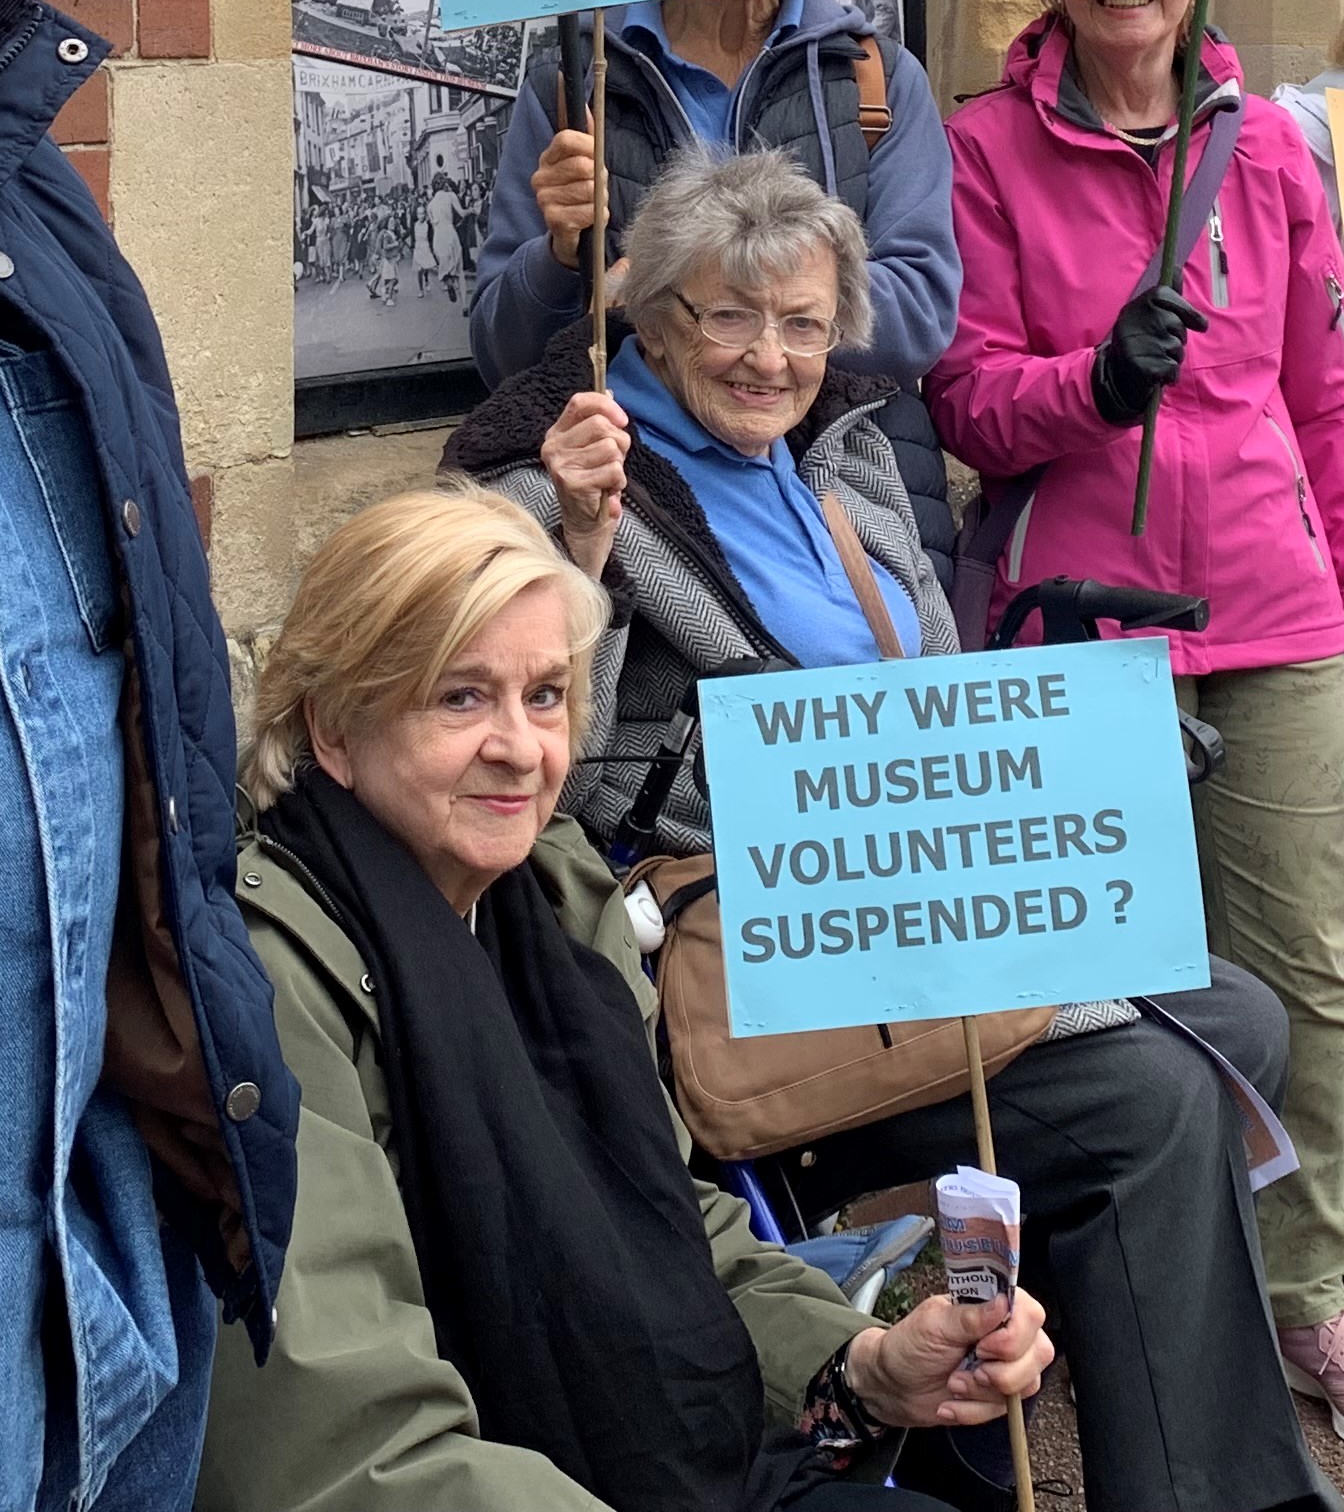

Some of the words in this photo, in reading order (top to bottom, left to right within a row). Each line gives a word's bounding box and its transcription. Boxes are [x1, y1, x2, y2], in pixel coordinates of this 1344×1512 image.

[299, 70, 356, 88] BRIXHAM
[751, 690, 887, 746] WHY
[904, 673, 1070, 730] WERE
[794, 746, 1044, 814] MUSEUM
[747, 809, 1128, 890] VOLUNTEERS
[741, 885, 1088, 964] SUSPENDED
[1106, 880, 1134, 925] ?
[950, 1273, 995, 1285] ITHOUT
